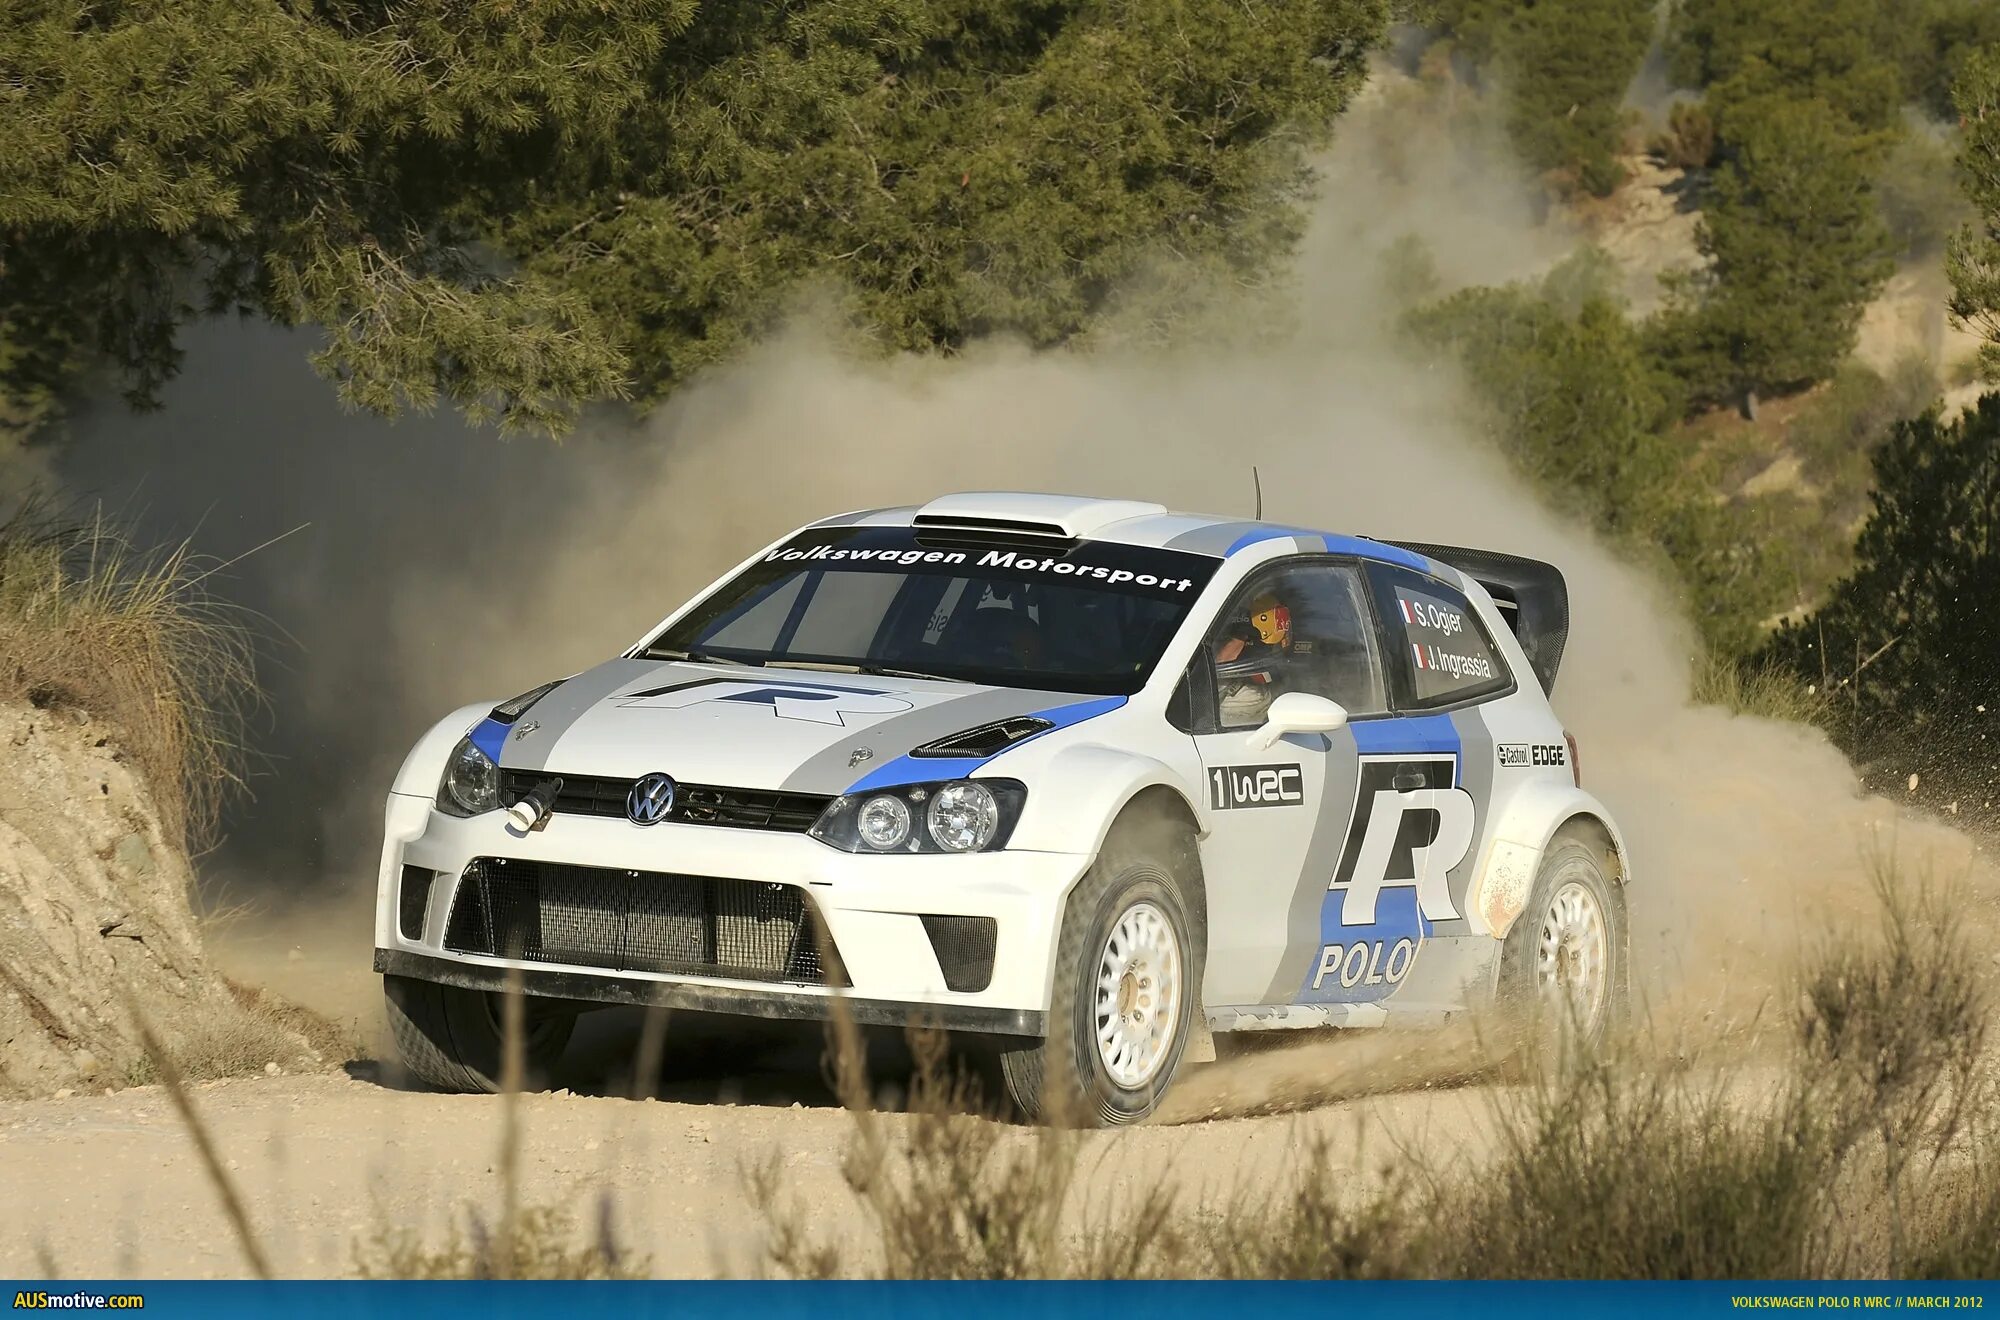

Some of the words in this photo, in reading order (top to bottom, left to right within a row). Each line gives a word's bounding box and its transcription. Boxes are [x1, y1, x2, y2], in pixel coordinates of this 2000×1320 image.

[765, 545, 967, 565] Volkswagen
[976, 550, 1193, 592] Motorsport
[1506, 747, 1529, 764] Castrol
[1531, 745, 1565, 766] EDGE
[1213, 768, 1225, 808] 1
[1232, 768, 1301, 803] WRC
[1337, 780, 1475, 926] R
[1311, 937, 1414, 990] POLO
